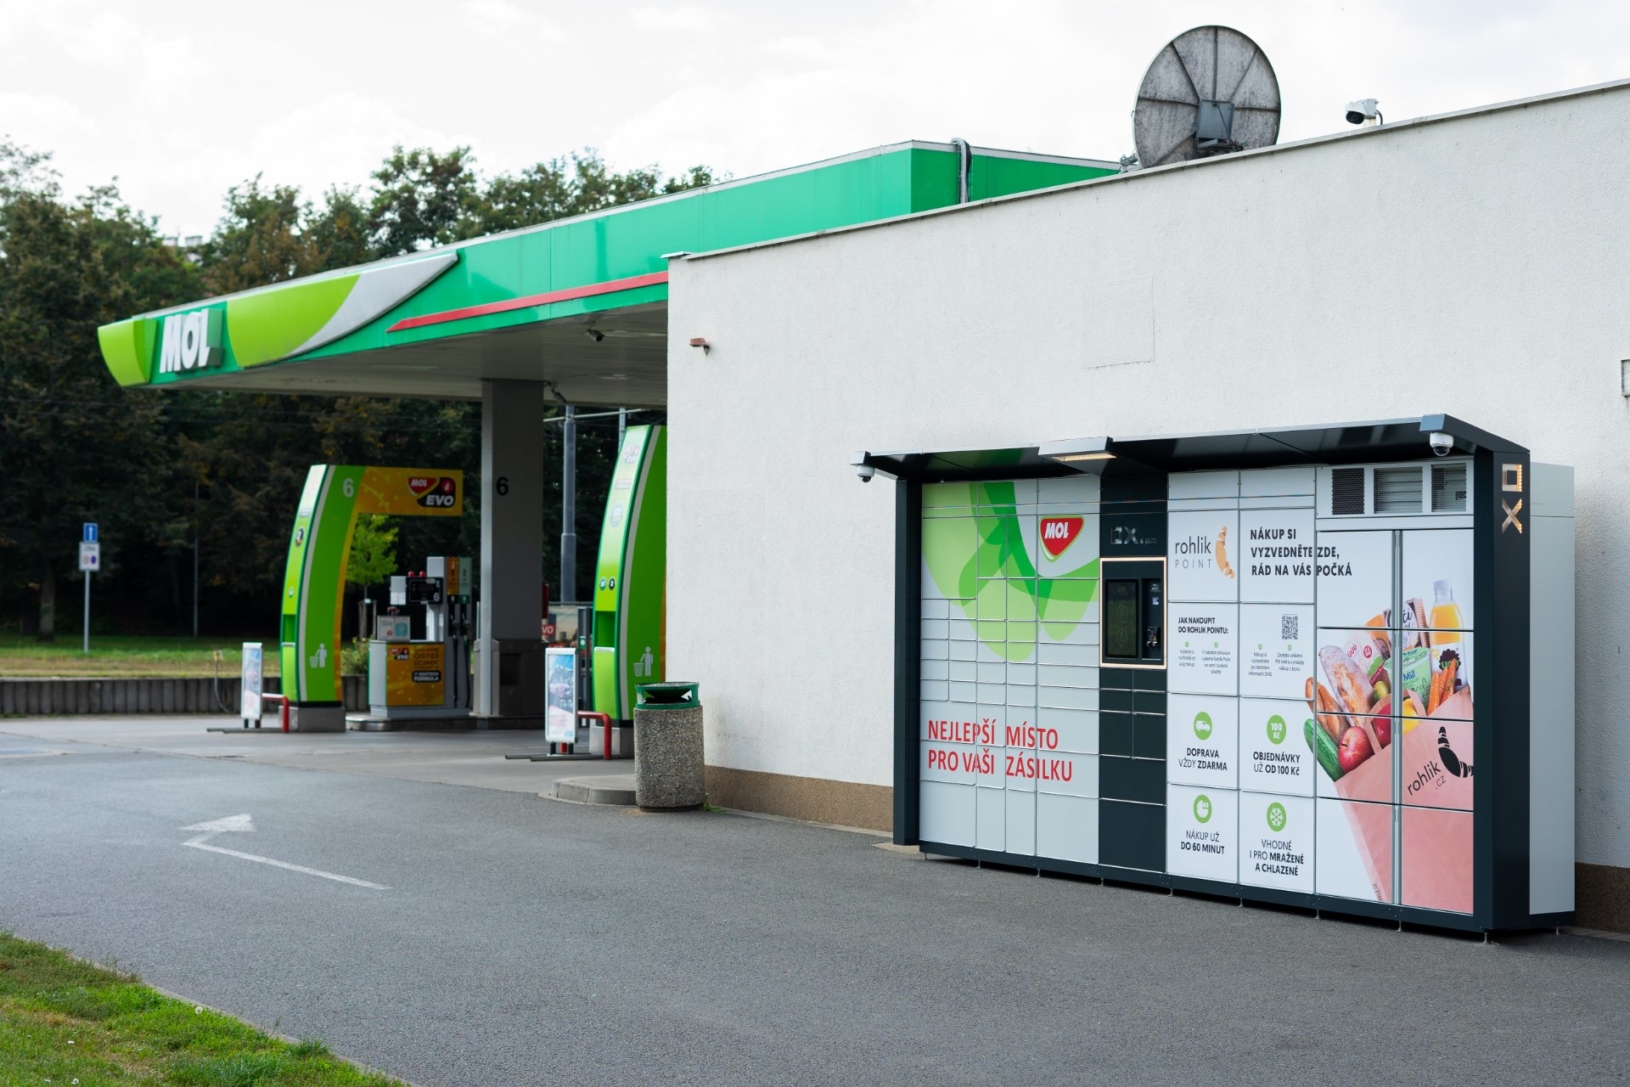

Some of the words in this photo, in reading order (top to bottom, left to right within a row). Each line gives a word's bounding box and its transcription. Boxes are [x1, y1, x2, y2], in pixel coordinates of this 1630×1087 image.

[159, 308, 210, 374] MOL
[343, 477, 354, 498] 6
[411, 479, 428, 487] MOL
[497, 477, 509, 496] 6
[426, 495, 455, 506] EVO
[1044, 521, 1069, 539] MOL
[1250, 527, 1285, 540] NÁKUP
[1288, 529, 1296, 540] SI
[1175, 536, 1212, 555] rohlik
[1251, 545, 1313, 558] VYZVEDNĚTE
[1317, 547, 1340, 560] ZDE,
[1175, 559, 1212, 569] POINT
[1251, 562, 1272, 576] RÁD
[1275, 565, 1289, 576] NA
[1293, 563, 1312, 576] VÁS
[1316, 562, 1352, 576] POČKÁ
[433, 592, 440, 602] 6
[928, 717, 996, 745] NEJLEPŠÍ
[1006, 720, 1059, 749] MÍSTO
[1270, 722, 1282, 731] 100
[1186, 747, 1219, 759] DOPRAVA
[1252, 751, 1300, 764] OBJEDNÁVKY
[928, 749, 959, 772] PRO
[962, 747, 995, 775] VAŠI
[1005, 751, 1073, 782] ZÁSILKU
[1178, 757, 1197, 769] VŽDY
[1197, 760, 1227, 771] ZDARMA
[1253, 762, 1264, 773] UŽ
[1264, 765, 1276, 775] OD
[1277, 766, 1289, 775] 100
[1290, 766, 1300, 776] Kč
[1407, 760, 1441, 796] rohlik
[1435, 775, 1447, 790] .cz
[1185, 829, 1209, 841] NÁKUP
[1210, 830, 1220, 843] UŽ
[1180, 841, 1191, 851] DO
[1192, 843, 1201, 852] 60
[1202, 844, 1225, 854] MINUT
[1261, 839, 1292, 851] VHODNÉ
[1253, 850, 1268, 861] PRO
[1269, 851, 1304, 865] MRAŽENÉ
[1255, 863, 1260, 872] A
[1262, 863, 1299, 876] CHLAZENÉ
